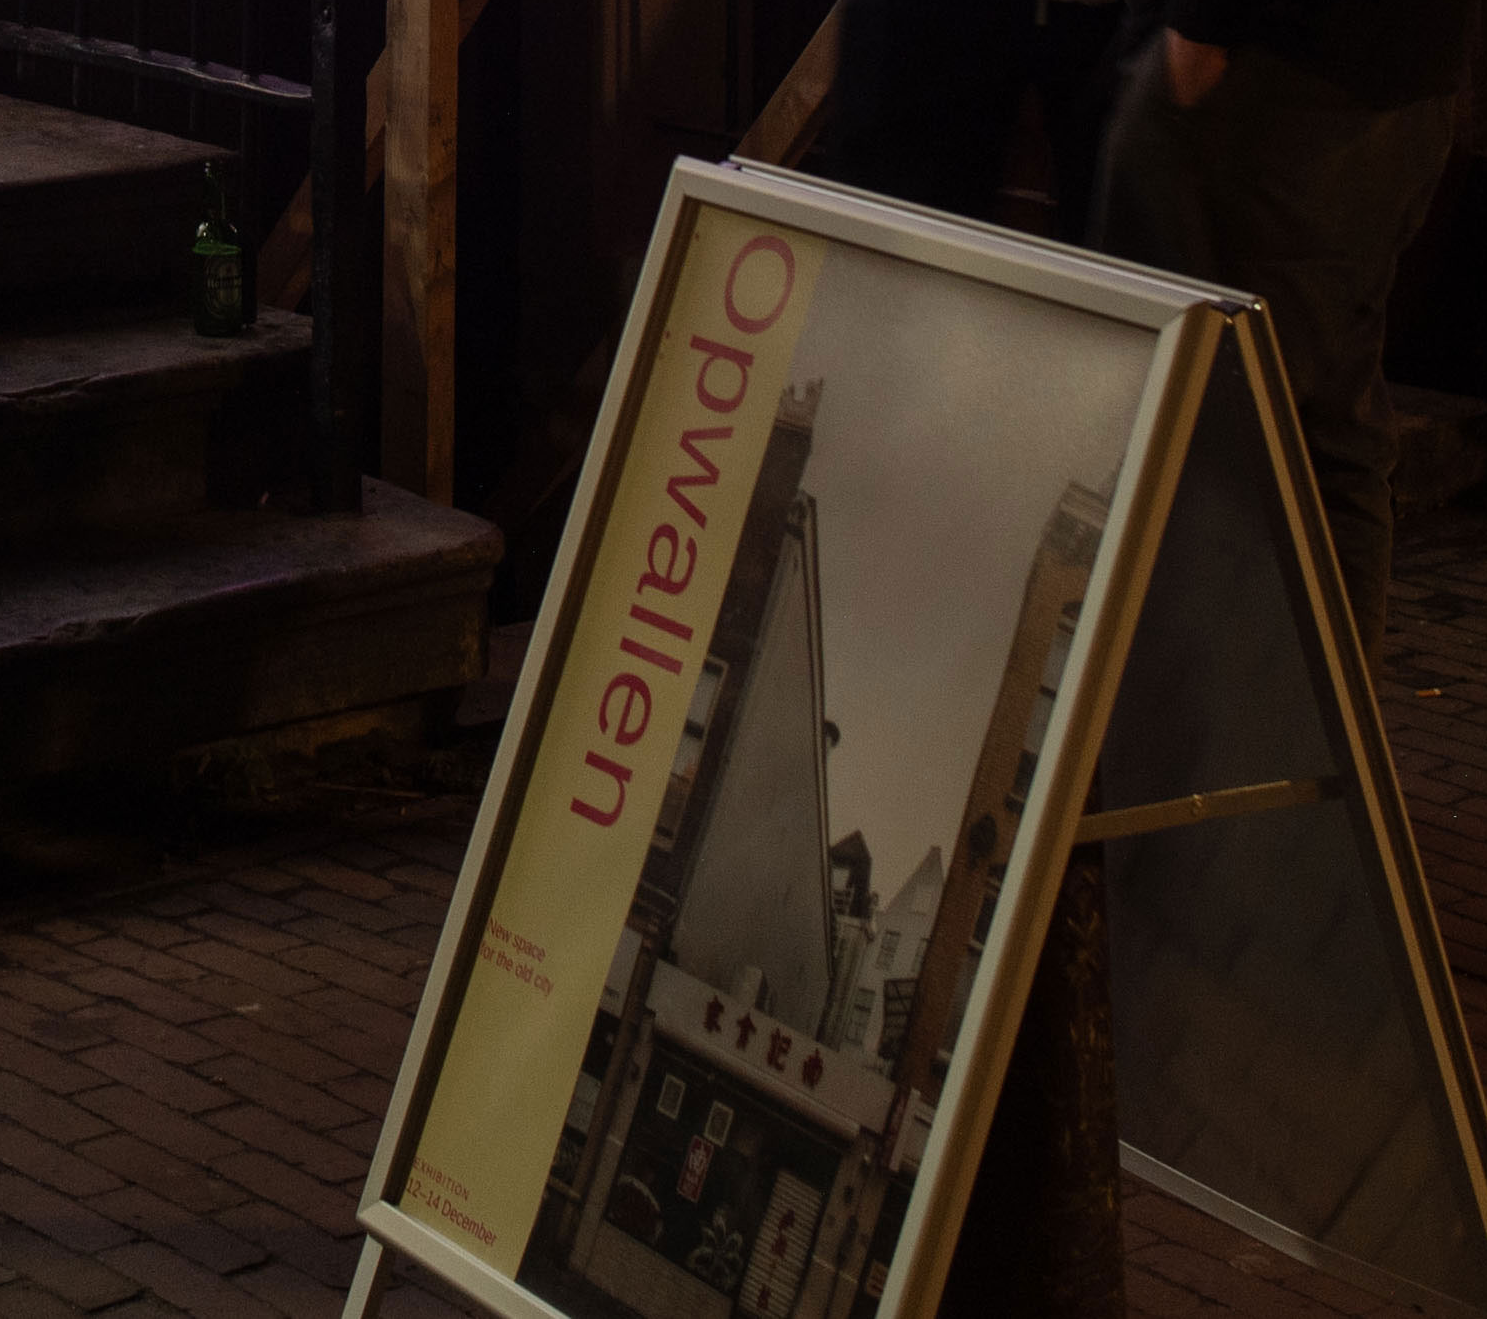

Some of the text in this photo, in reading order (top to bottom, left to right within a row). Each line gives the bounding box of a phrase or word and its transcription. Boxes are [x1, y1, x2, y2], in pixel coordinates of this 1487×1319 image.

[570, 235, 796, 828] Opwallen
[490, 915, 545, 964] New space
[496, 951, 514, 971] the
[515, 964, 534, 983] old
[534, 974, 554, 996] city
[413, 1156, 470, 1202] EXHIBITION
[441, 1198, 497, 1247] December
